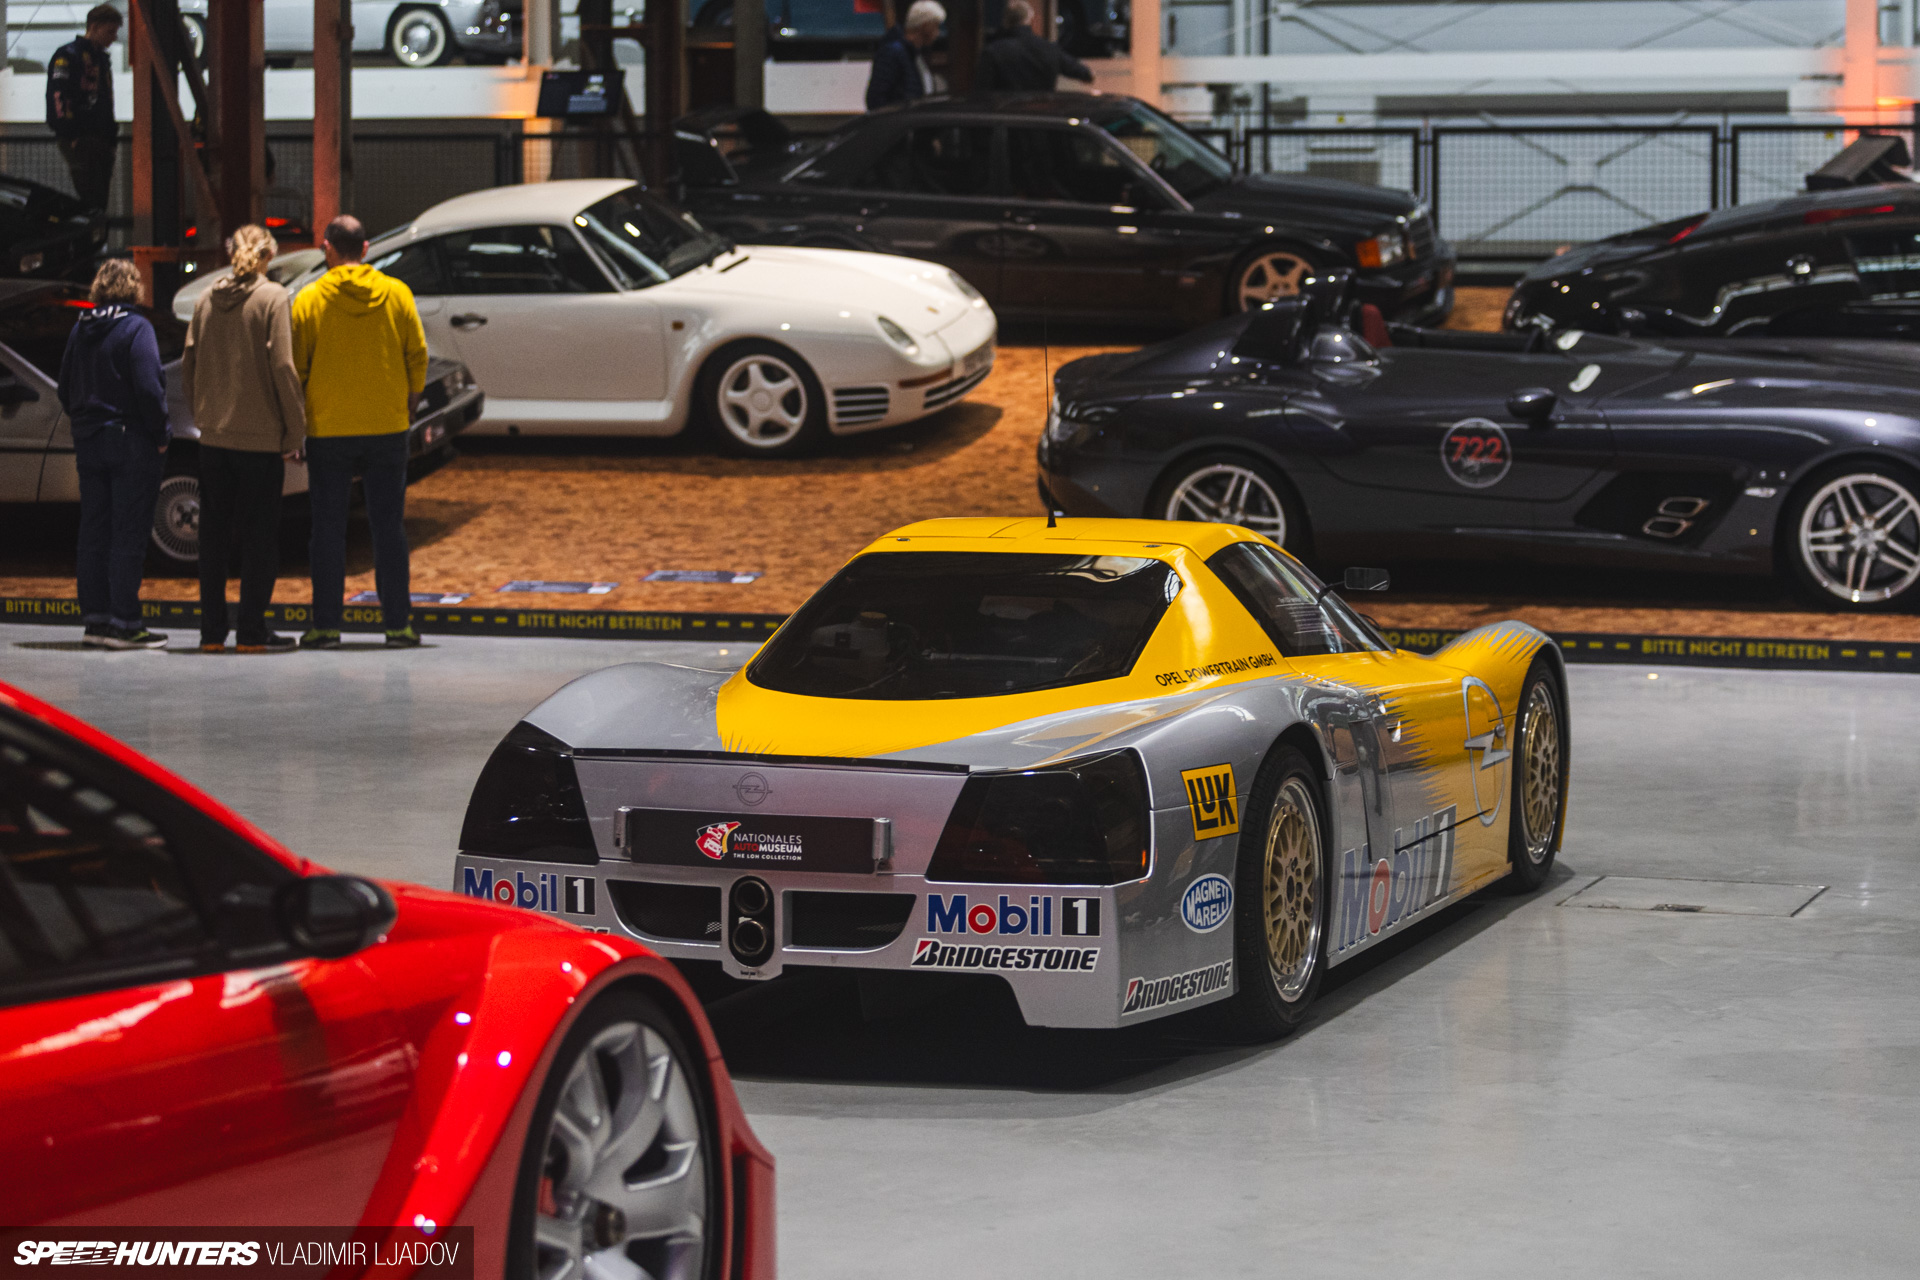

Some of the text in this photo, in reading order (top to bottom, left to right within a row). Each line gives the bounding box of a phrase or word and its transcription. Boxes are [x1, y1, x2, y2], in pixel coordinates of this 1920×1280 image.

[1450, 436, 1503, 463] 722
[6, 600, 82, 616] BITTE NICH
[284, 607, 307, 621] DO
[343, 608, 383, 623] CROS
[518, 613, 683, 630] BITTE NICHT BETRETEN
[1404, 632, 1440, 648] NOT
[1641, 639, 1831, 660] BITTE NICHT BETRETEN
[1155, 652, 1277, 687] OPEL POWERTRAIN GMBH
[733, 832, 802, 845] NATIONALES
[733, 842, 802, 853] AUTOMUSEUM
[464, 867, 558, 911] Mobil
[1337, 815, 1429, 954] Mobil
[927, 894, 1052, 936] Mobil
[911, 938, 1099, 972] BRIDGESTONE
[1122, 960, 1233, 1014] BRIDGESTONE
